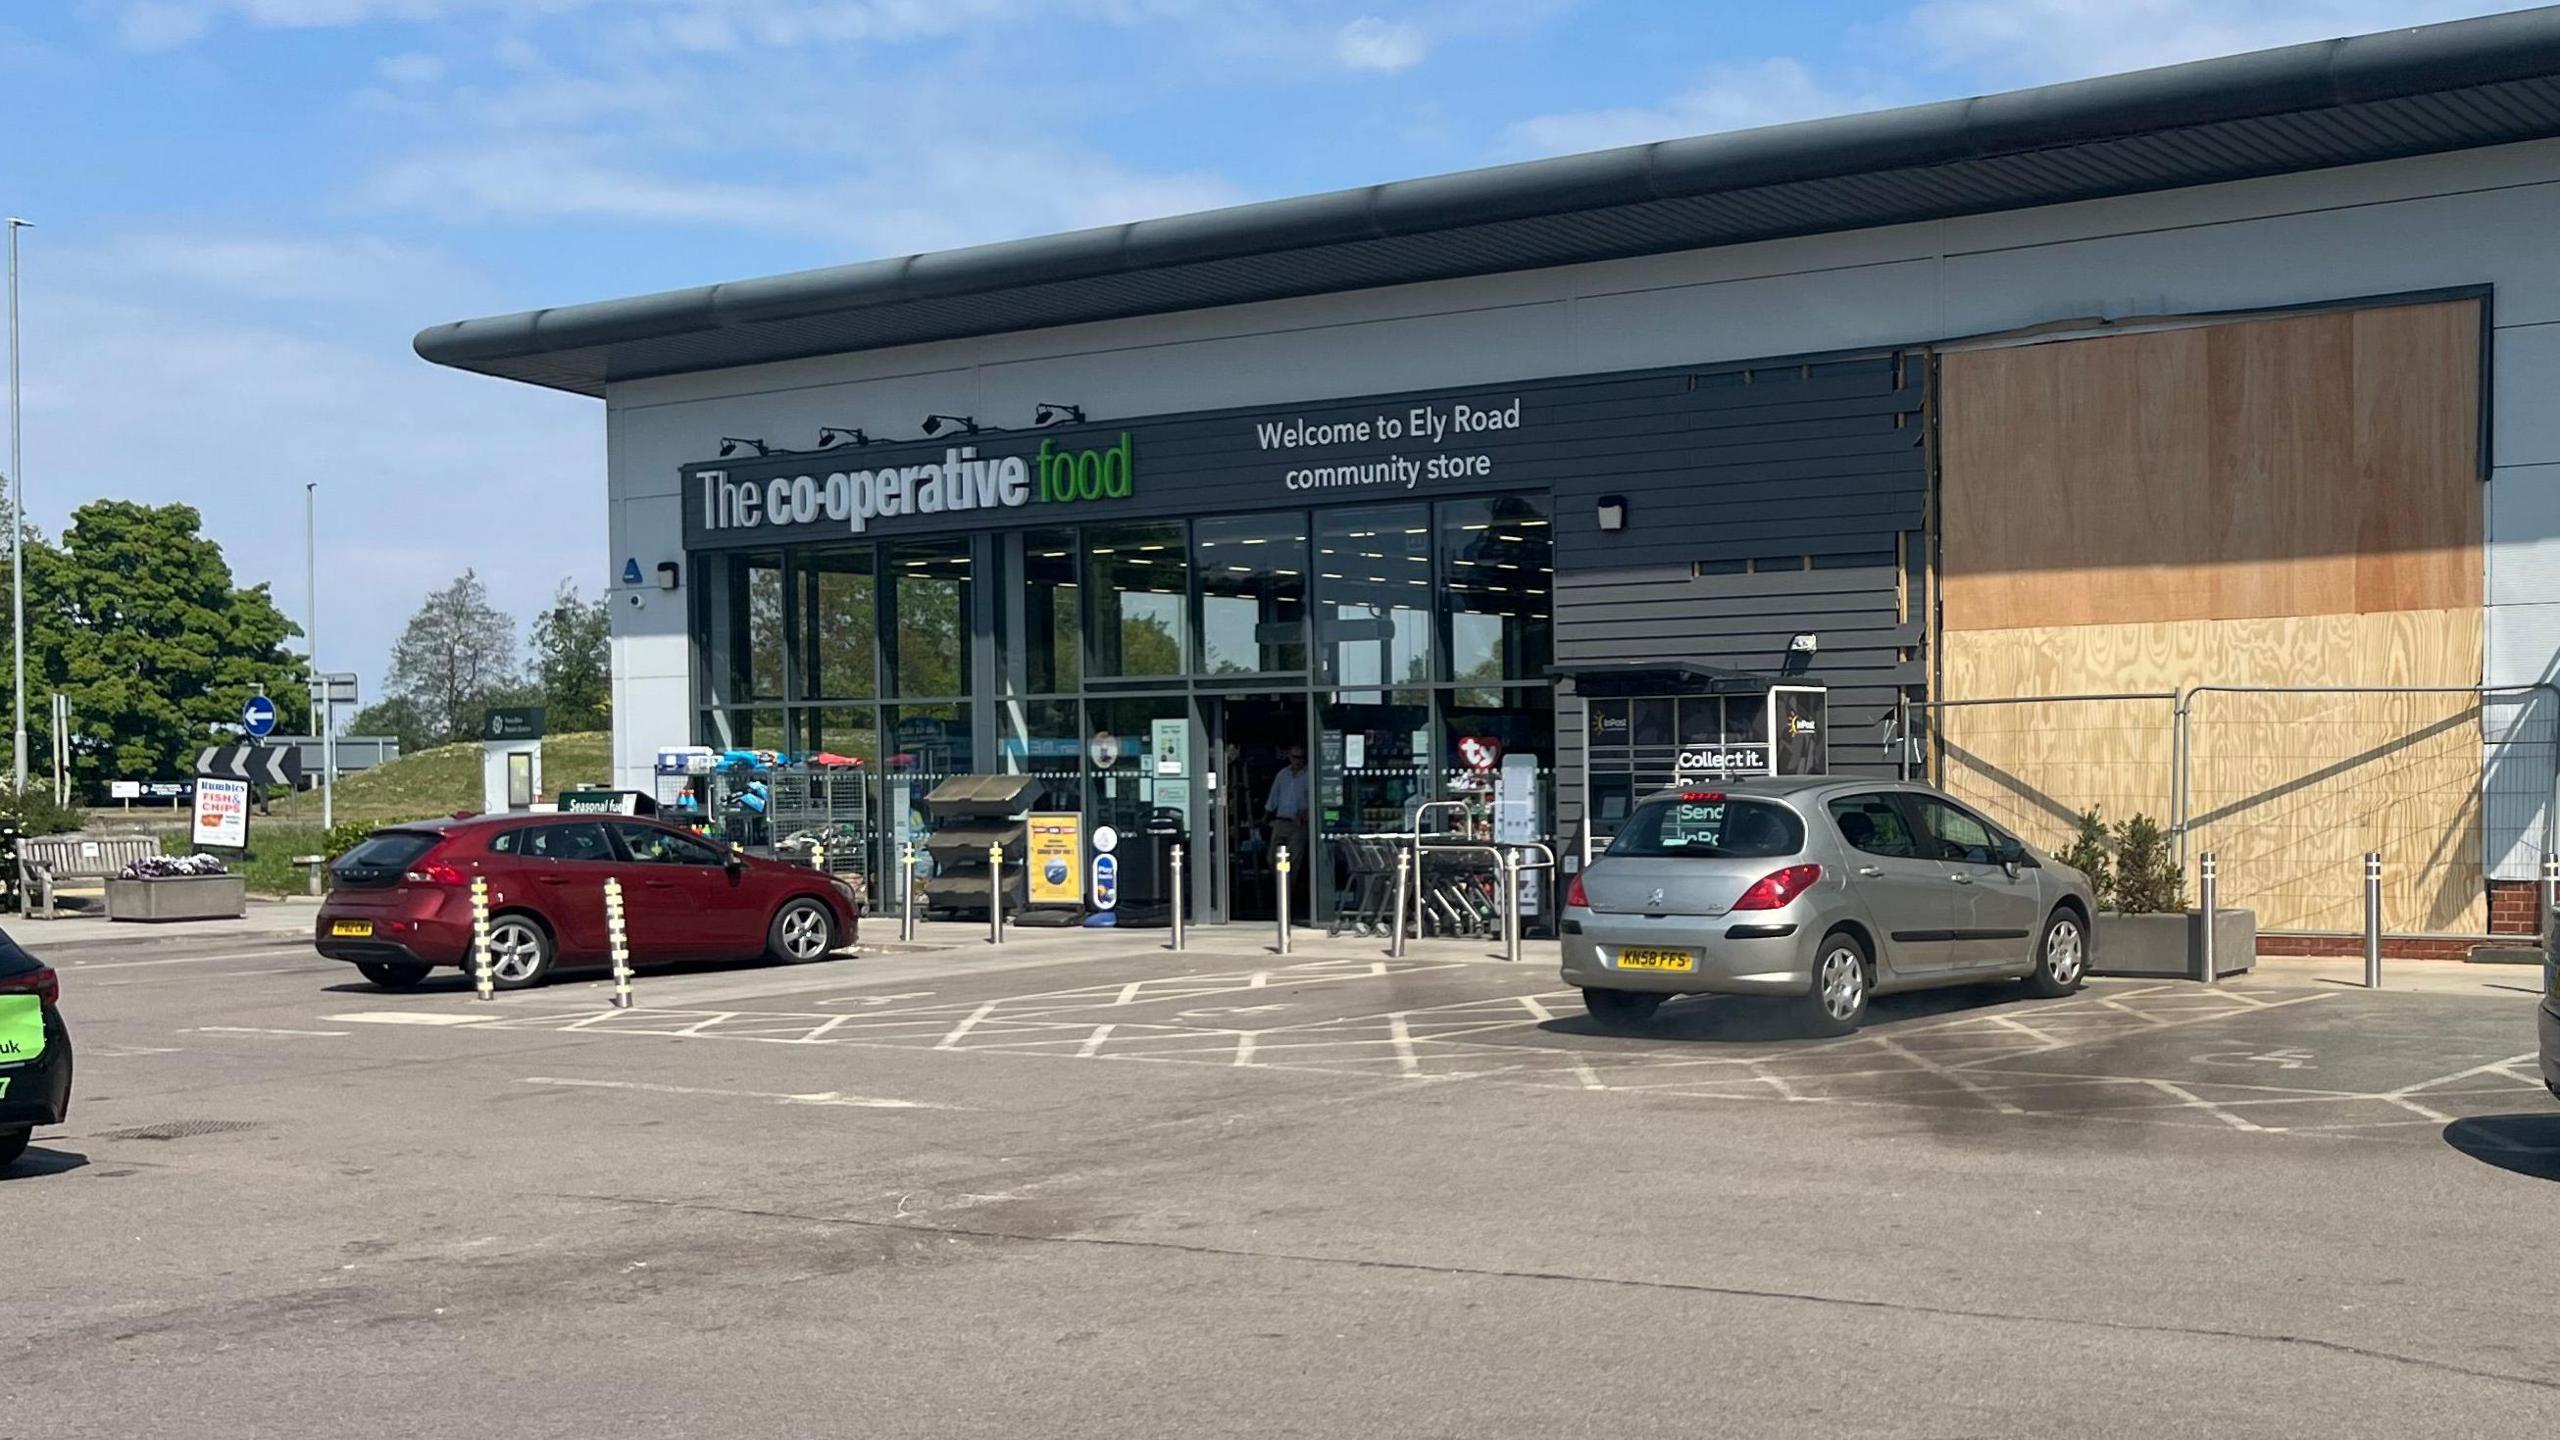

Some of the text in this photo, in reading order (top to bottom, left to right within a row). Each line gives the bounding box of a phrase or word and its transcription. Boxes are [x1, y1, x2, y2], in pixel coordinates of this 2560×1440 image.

[1257, 398, 1521, 450] Welcome to Ely Road
[1285, 454, 1492, 490] community store
[696, 431, 1133, 533] The co-operative food
[1461, 738, 1496, 767] ty
[1679, 750, 1764, 768] Collect it.
[203, 792, 231, 803] FISH
[570, 798, 609, 812] Seasonal
[203, 802, 241, 814] CHIPS
[1681, 804, 1725, 819] Send
[1623, 950, 1687, 968] KN58 FFS
